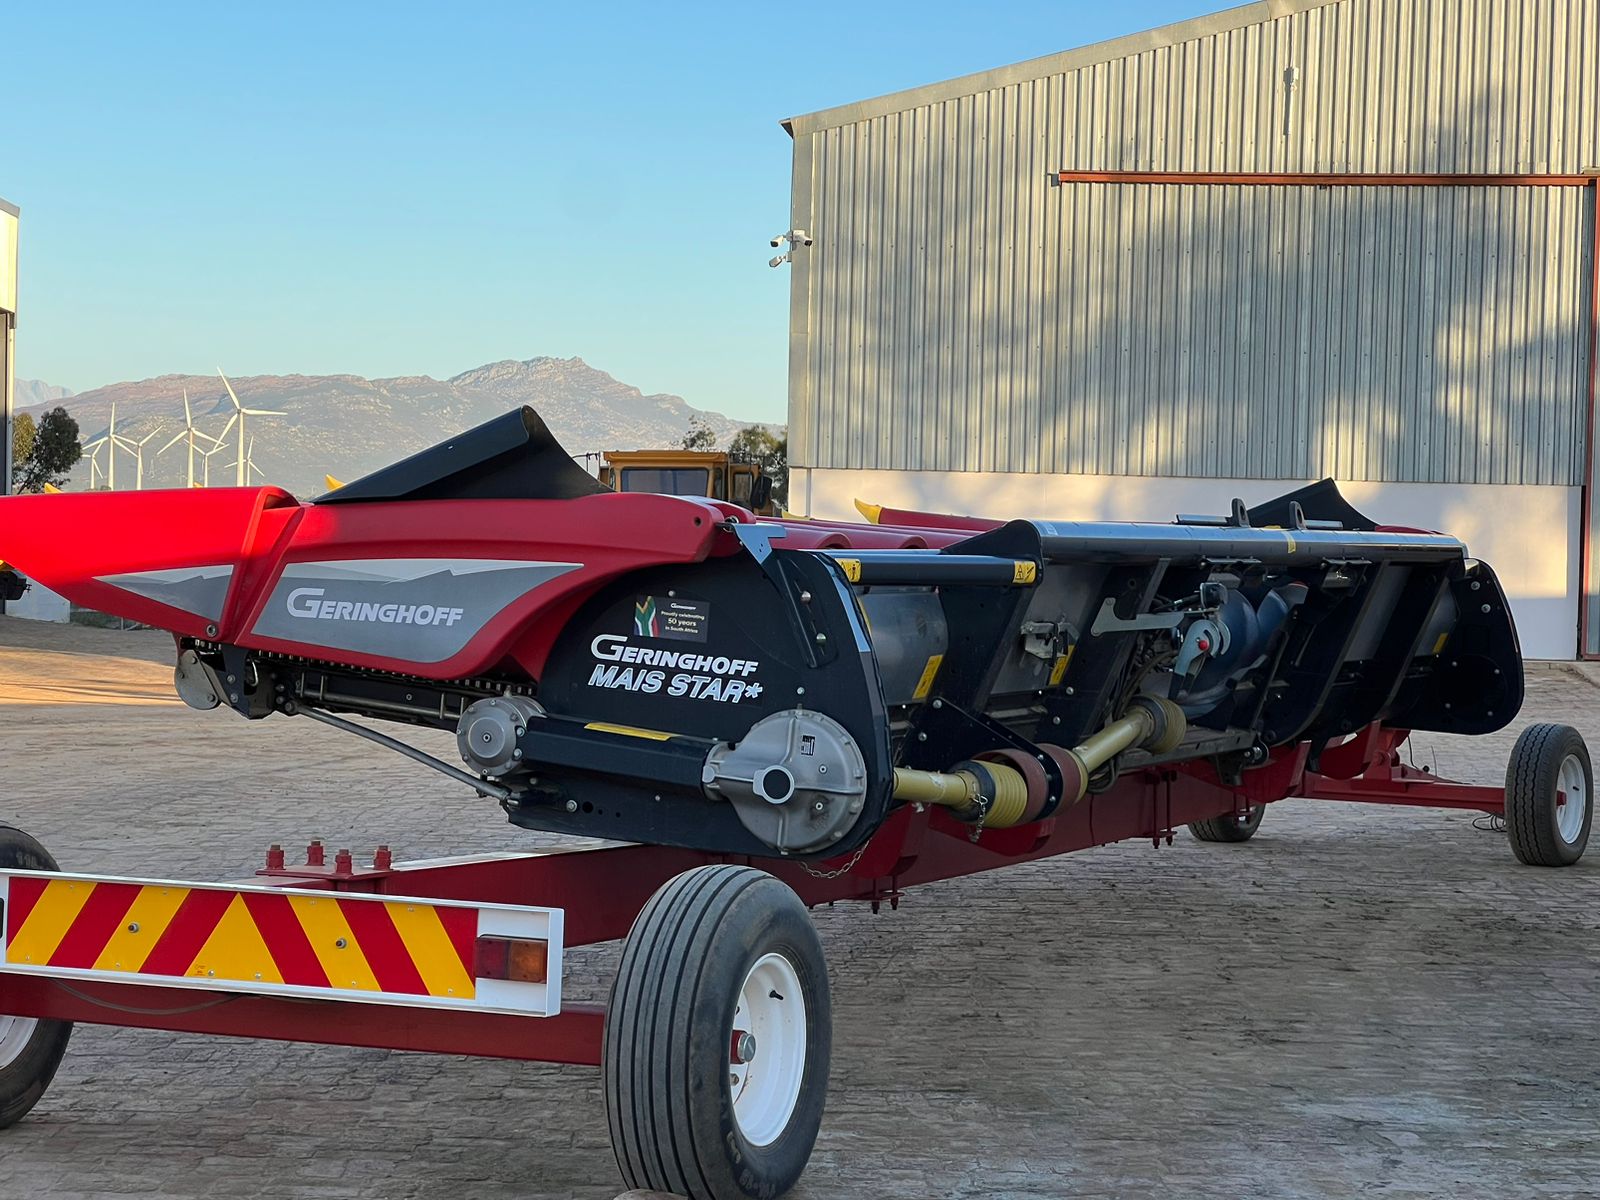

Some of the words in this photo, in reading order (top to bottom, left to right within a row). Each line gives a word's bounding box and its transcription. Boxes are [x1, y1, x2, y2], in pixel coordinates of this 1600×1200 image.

[286, 587, 464, 626] GERINGHOFF
[678, 612, 704, 620] celebrating
[590, 634, 759, 677] GERINGHOFF
[588, 664, 666, 693] MAIS
